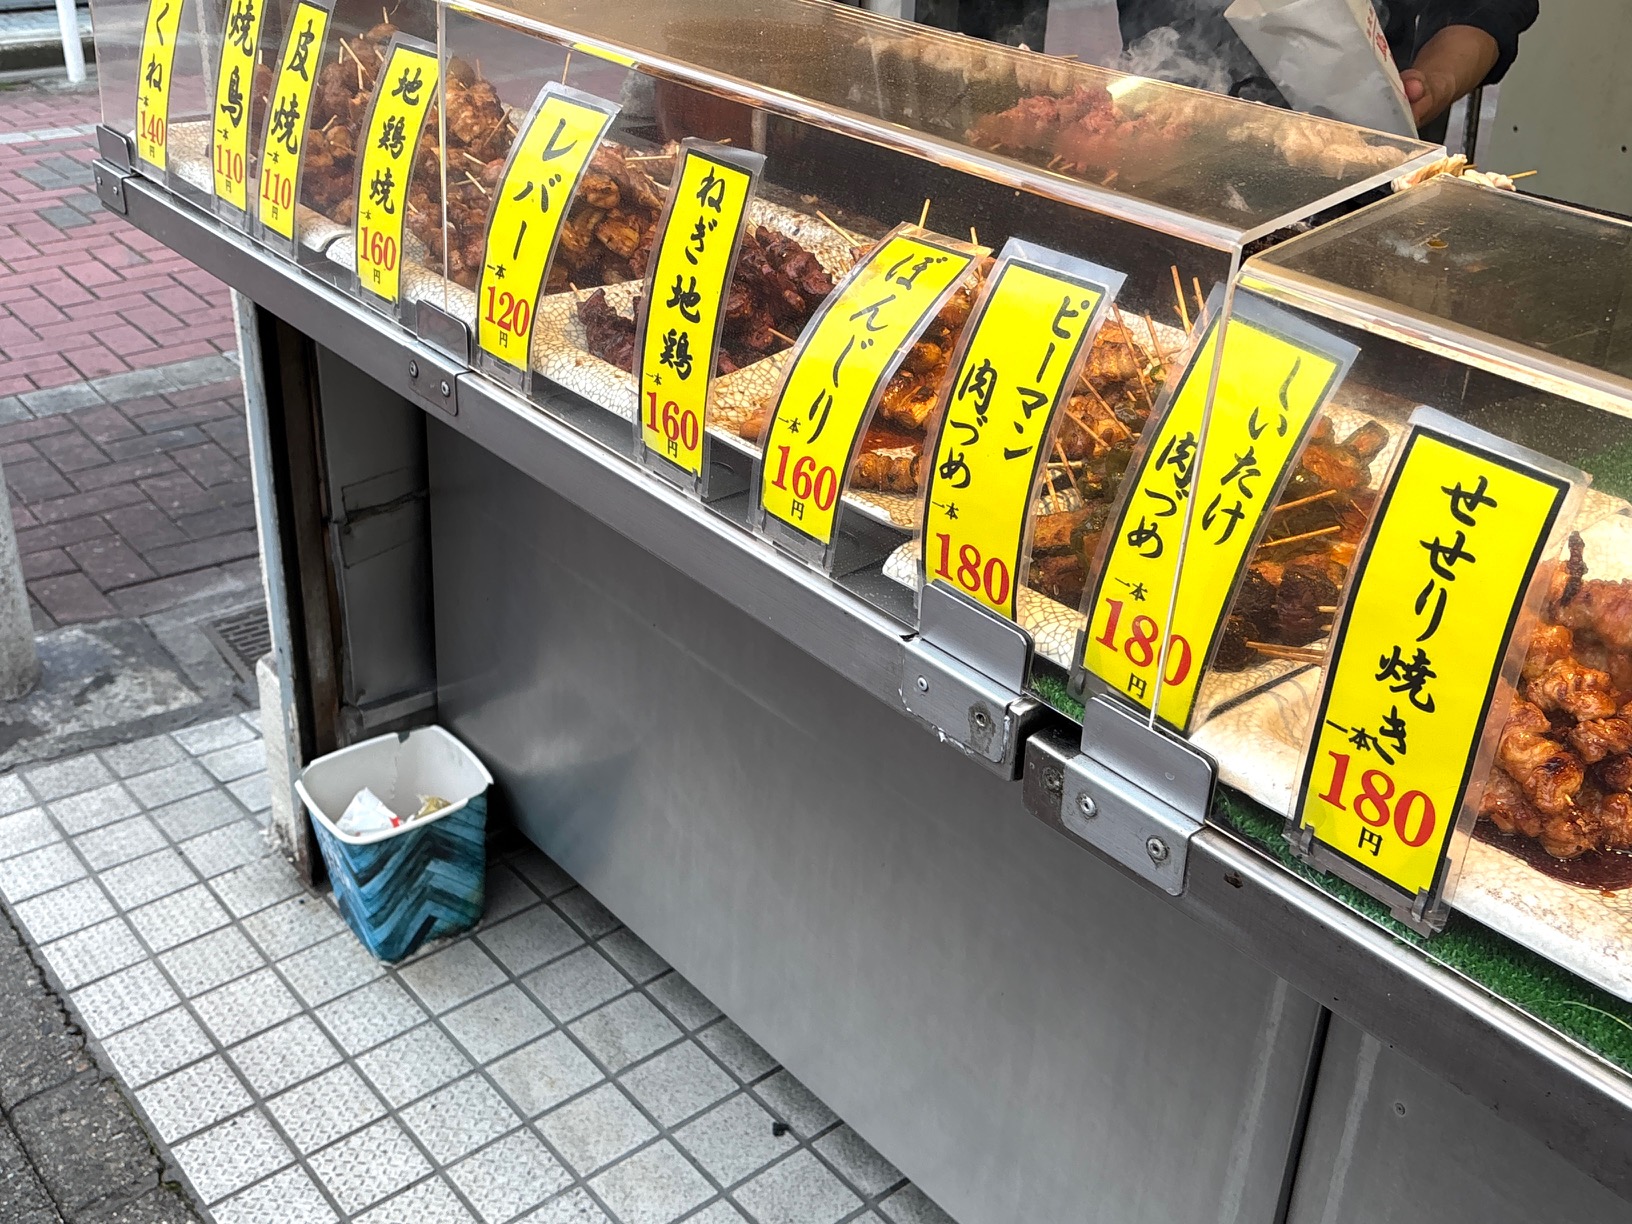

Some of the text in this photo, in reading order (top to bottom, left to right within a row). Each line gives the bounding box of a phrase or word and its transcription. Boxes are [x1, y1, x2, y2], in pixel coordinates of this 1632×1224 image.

[220, 0, 255, 128] 焼鳥
[138, 96, 149, 107] 一本
[271, 18, 315, 155] 皮焼
[140, 110, 164, 147] 140
[217, 128, 229, 141] 一本
[369, 67, 423, 215] 地鶏焼
[149, 145, 155, 158] 円
[216, 144, 243, 184] 110
[267, 151, 279, 164] 一本
[225, 181, 232, 193] 円
[262, 168, 292, 210] 110
[513, 118, 578, 260] レバー
[271, 206, 279, 221] 円
[360, 210, 371, 220] 一本
[360, 226, 397, 271] 160
[373, 267, 381, 284] 円
[487, 263, 505, 280] 一本
[659, 166, 726, 380] ねぎ地鶏
[485, 286, 530, 337] 120
[499, 331, 508, 348] 円
[806, 252, 948, 444] ぼんじり
[646, 373, 662, 386] 一本
[1003, 295, 1090, 460] ピーマン
[646, 391, 699, 451] 160
[777, 416, 802, 434] 一本
[938, 358, 998, 488] 肉づめ
[667, 439, 678, 458] 円
[1202, 356, 1301, 546] しいたけ
[771, 445, 837, 511] 160
[1127, 431, 1198, 559] 肉づめ
[790, 499, 804, 520] 円
[931, 502, 959, 520] 一本
[935, 533, 1010, 605] 180
[1114, 577, 1148, 602] 一本
[1374, 475, 1498, 765] せせり焼き
[1095, 598, 1192, 686] 180
[1127, 672, 1147, 700] 円
[1326, 719, 1370, 753] 一本
[1318, 751, 1436, 848] 180
[1358, 826, 1383, 857] 円
